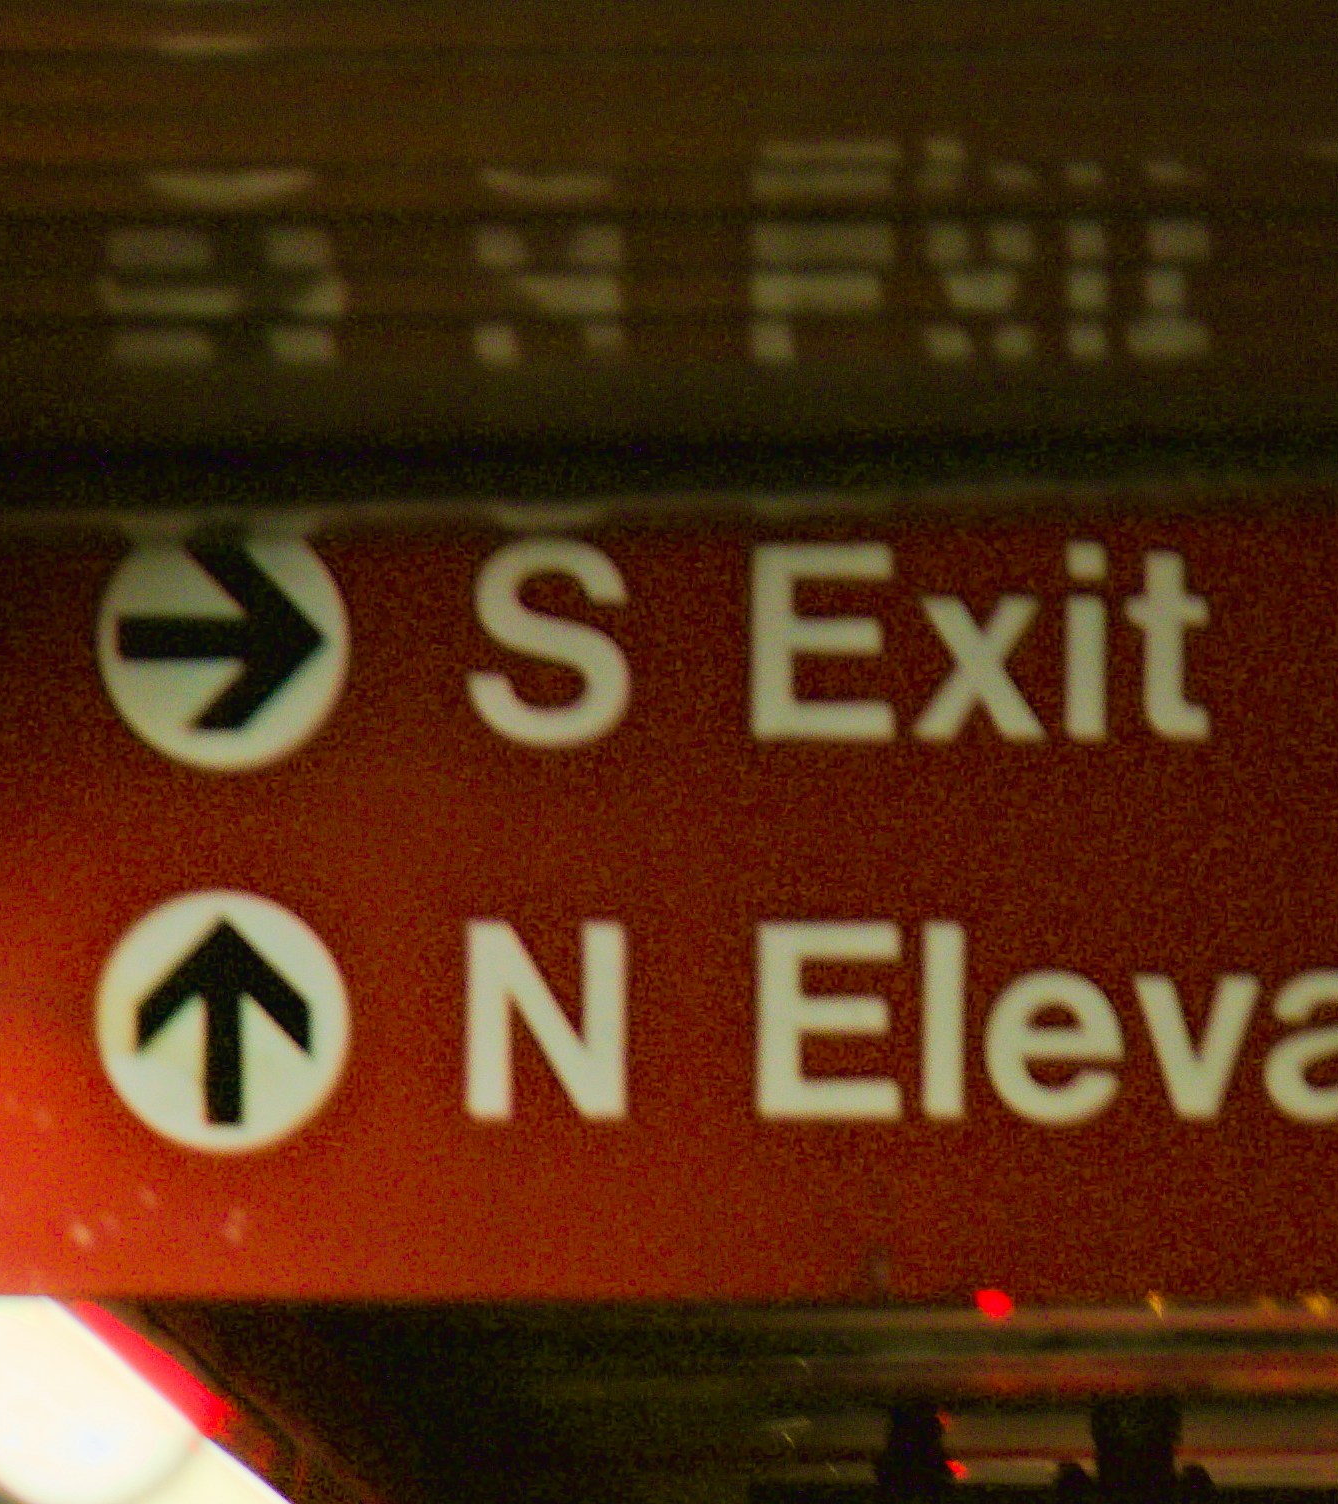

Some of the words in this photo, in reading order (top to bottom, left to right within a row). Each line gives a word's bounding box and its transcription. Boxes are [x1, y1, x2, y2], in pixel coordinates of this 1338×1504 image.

[467, 536, 633, 748] S
[749, 540, 1213, 742] Exit
[465, 918, 629, 1122] N
